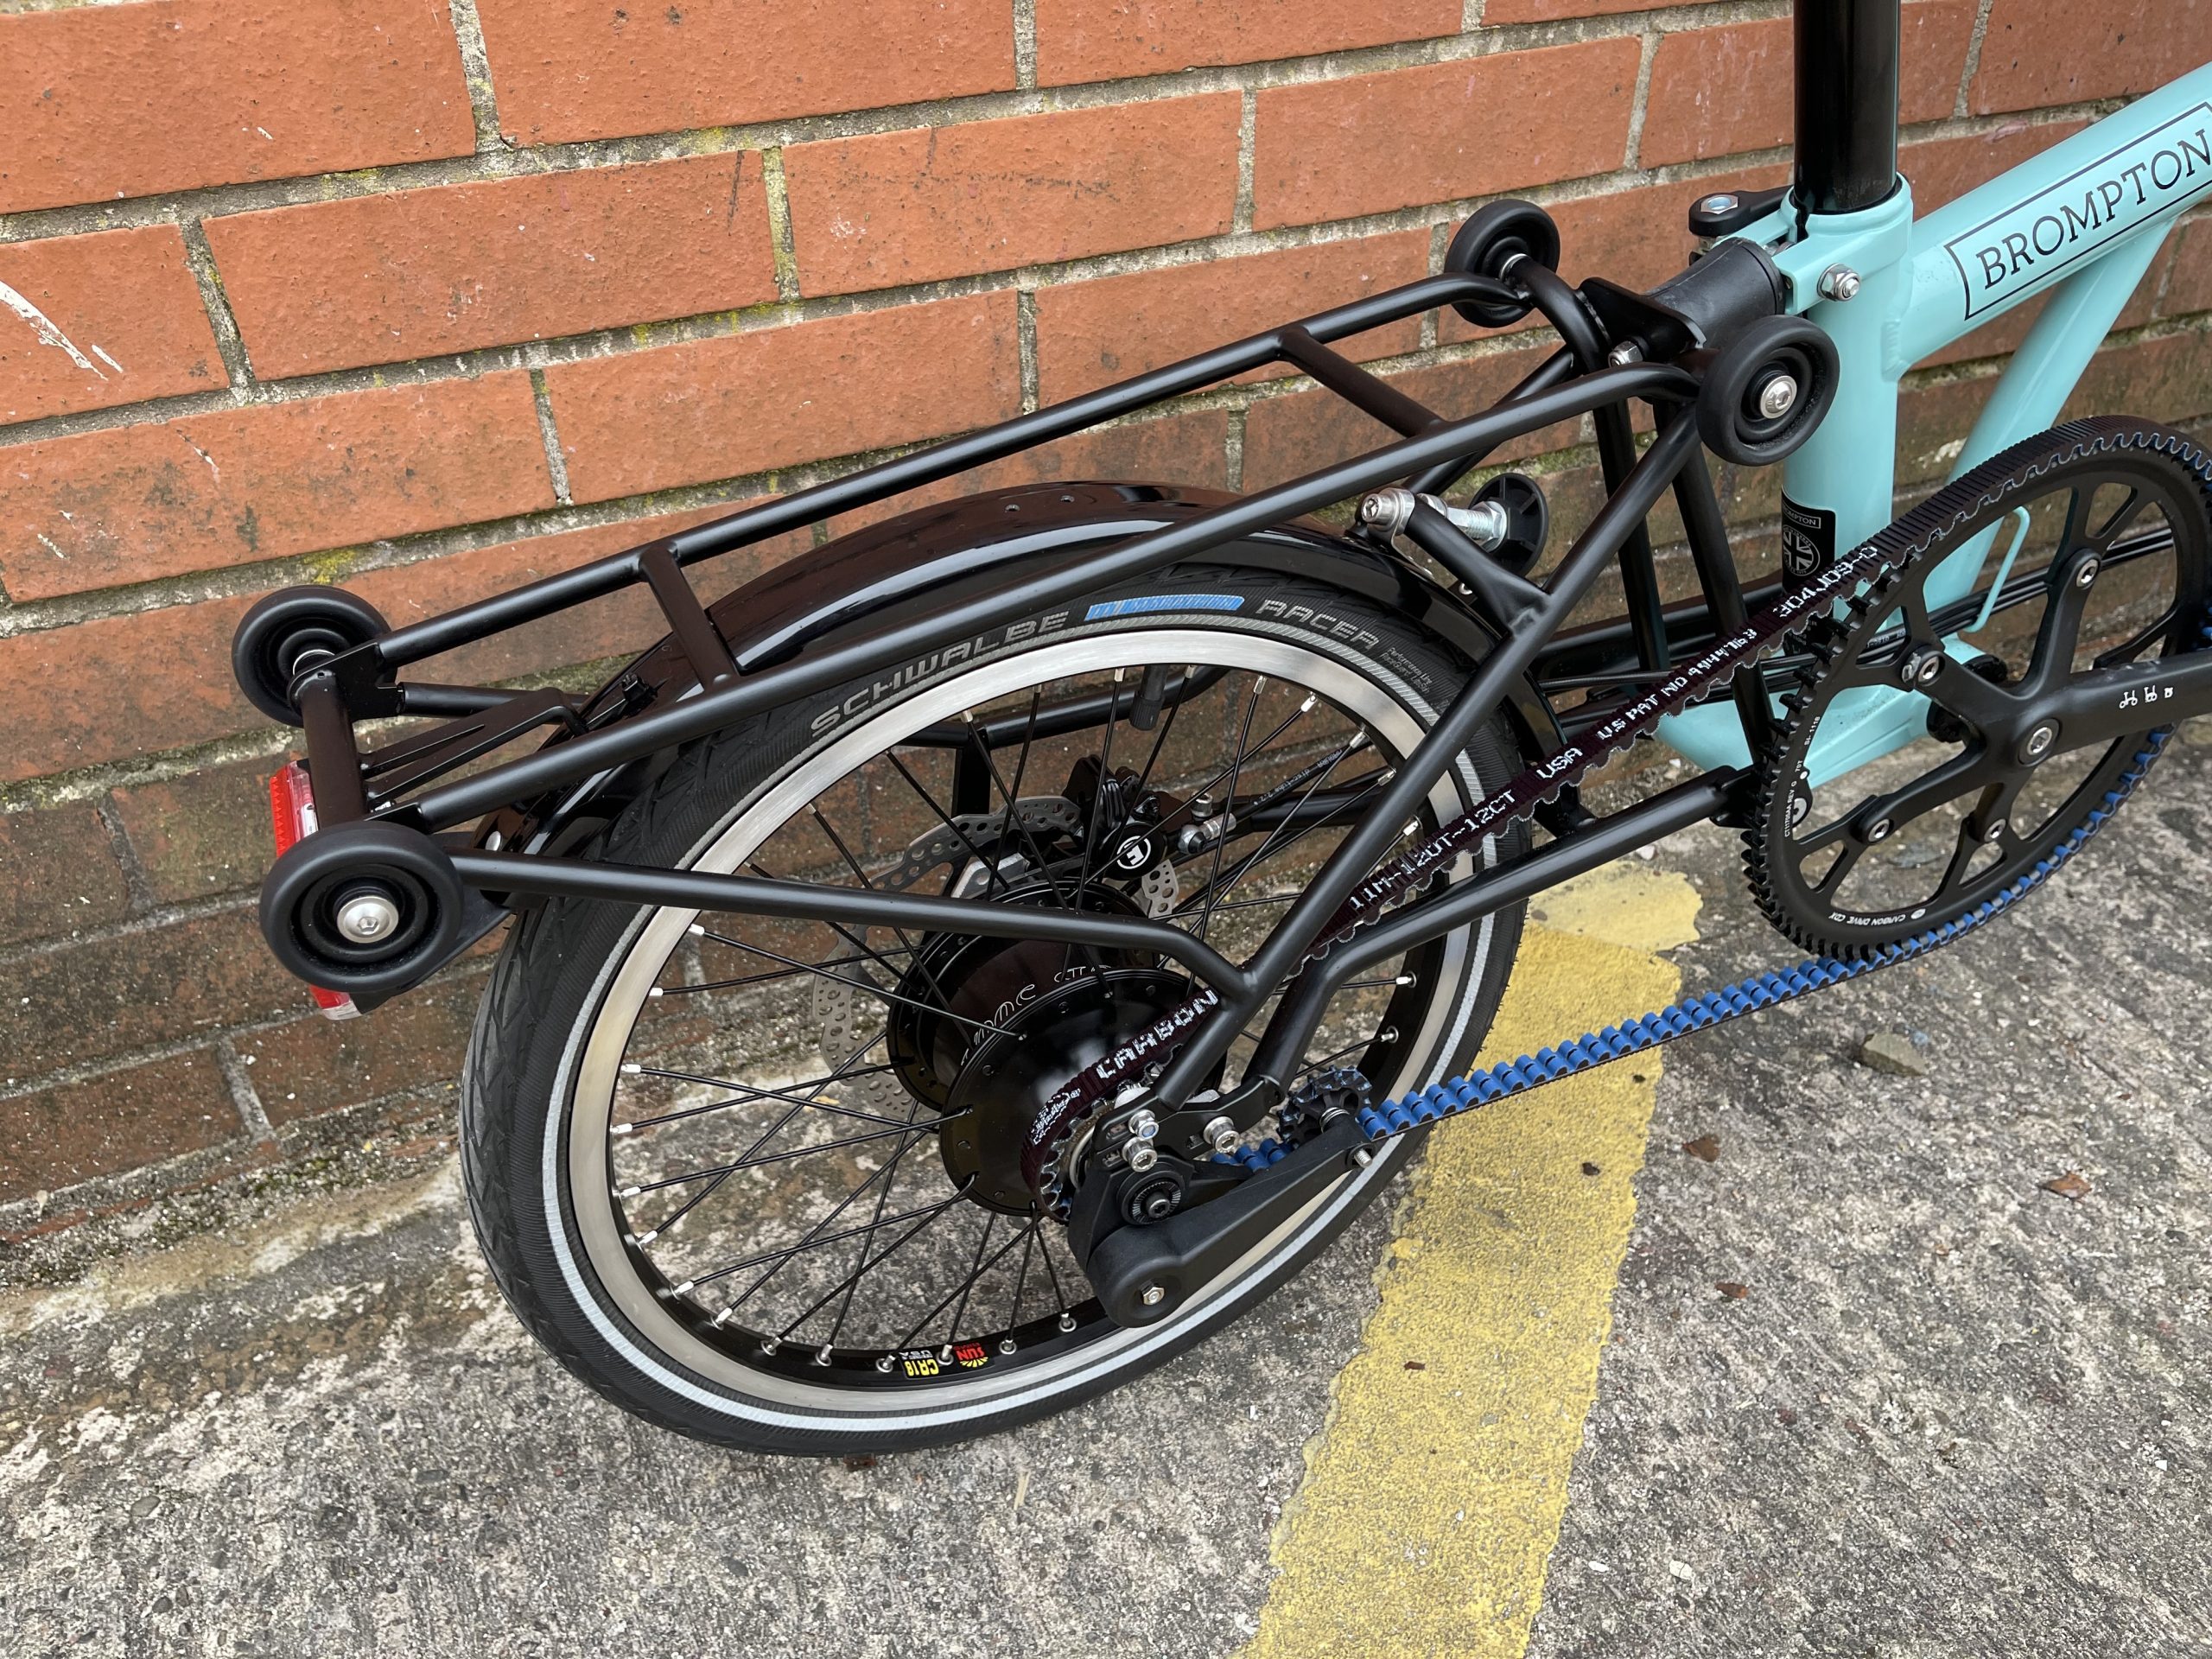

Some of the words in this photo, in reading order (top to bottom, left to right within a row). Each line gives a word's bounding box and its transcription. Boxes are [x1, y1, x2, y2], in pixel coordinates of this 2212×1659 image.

[1975, 130, 2212, 290] BROMPTON
[1255, 599, 1380, 650] RACER
[810, 610, 1070, 738] SCHWALBE
[1536, 747, 1583, 779] USA
[1597, 718, 1626, 741] US
[1625, 693, 1659, 721] PAT
[1661, 676, 1688, 696] NO
[1787, 789, 1796, 804] REV
[1828, 912, 1847, 923] CDX
[1847, 916, 1871, 926] DRIVE
[1870, 914, 1906, 926] CARBON
[1096, 989, 1218, 1078] CARBON
[956, 1346, 985, 1361] SUN
[904, 1358, 939, 1376] CR18
